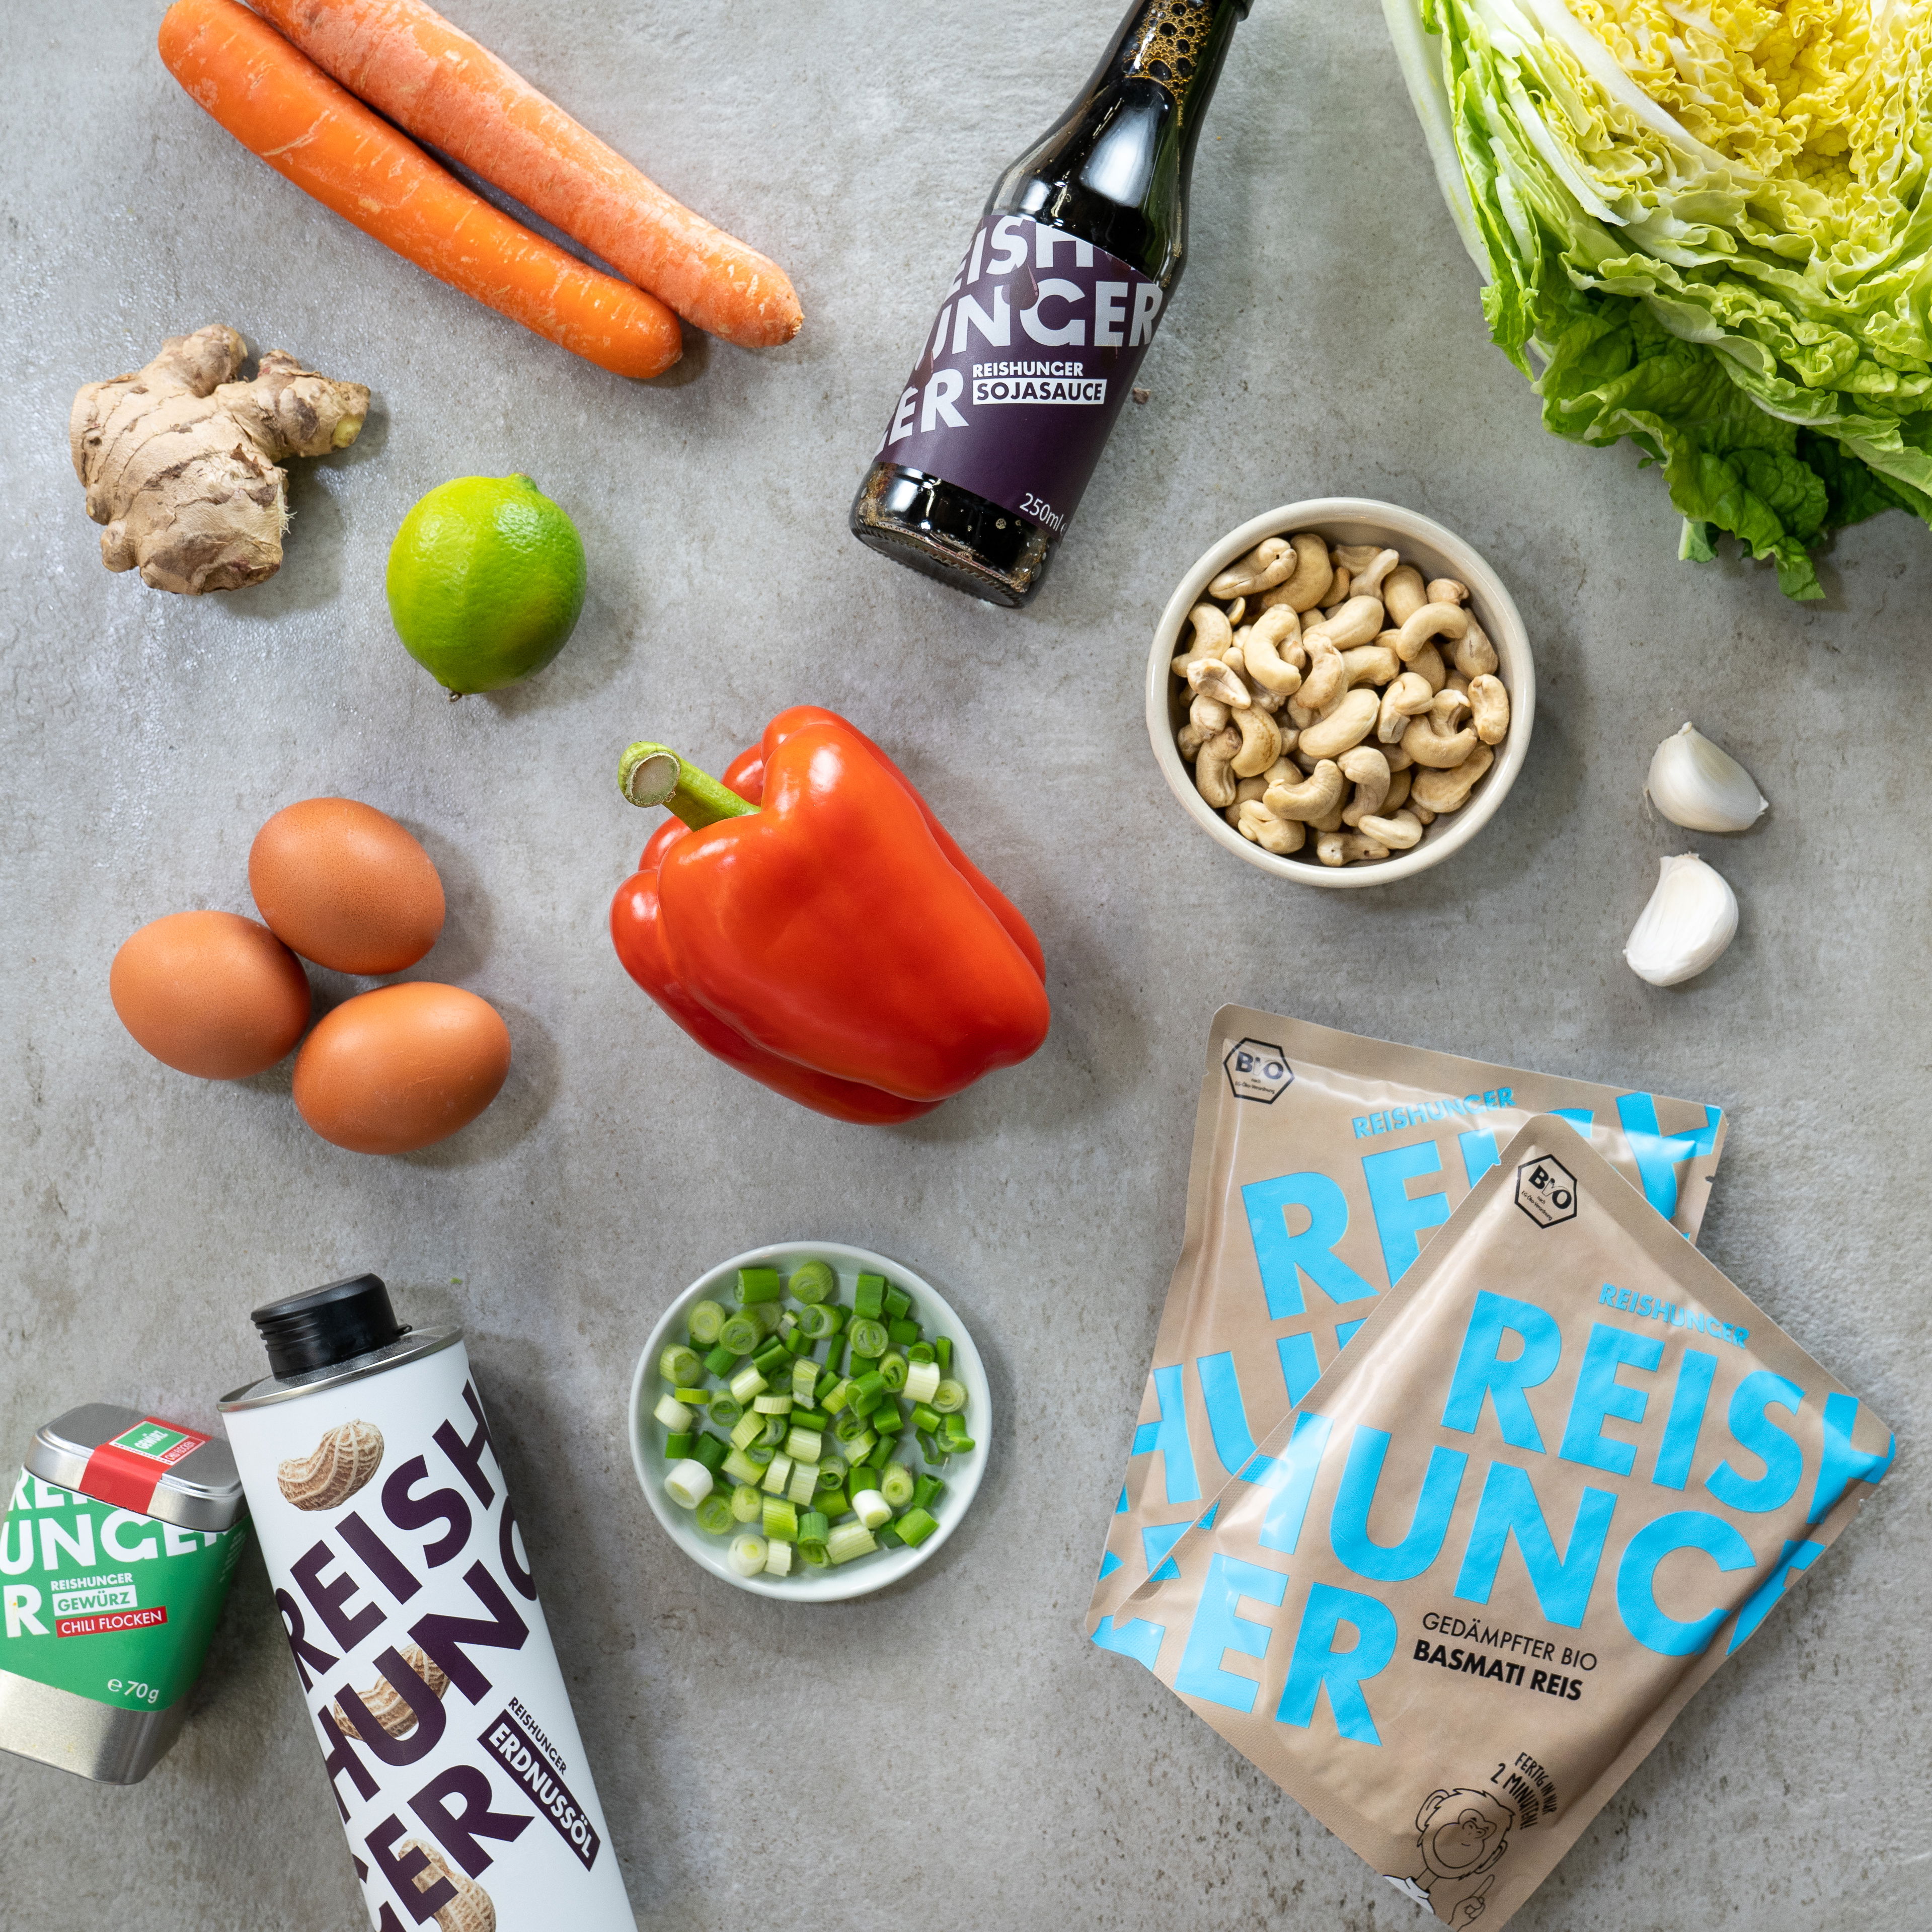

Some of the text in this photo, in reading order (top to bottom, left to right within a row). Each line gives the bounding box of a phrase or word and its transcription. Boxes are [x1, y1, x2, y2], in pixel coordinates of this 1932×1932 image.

[973, 361, 1083, 377] REISHUNGER
[977, 381, 1102, 401] SOJASAUCE
[877, 368, 969, 455] ER
[1020, 493, 1064, 531] 250ml
[1352, 1087, 1516, 1139] REISHUNGER
[1598, 1283, 1749, 1349] REISHUNGER
[0, 1509, 229, 1575] UNGE
[51, 1573, 133, 1591] REISHUNGER
[58, 1590, 130, 1612] GEWÜRZ
[61, 1610, 163, 1634] CHILI FLOCKEN
[1422, 1612, 1597, 1671] GEDÄMPFTER BIO
[1413, 1639, 1583, 1701] BASMATI REIS
[508, 1696, 567, 1775] REISHUNGER
[488, 1722, 592, 1858] ERDNUSSÖL
[1490, 1762, 1539, 1830] 2 MINUTEN!
[1515, 1752, 1557, 1815] FERTIG IN NUR
